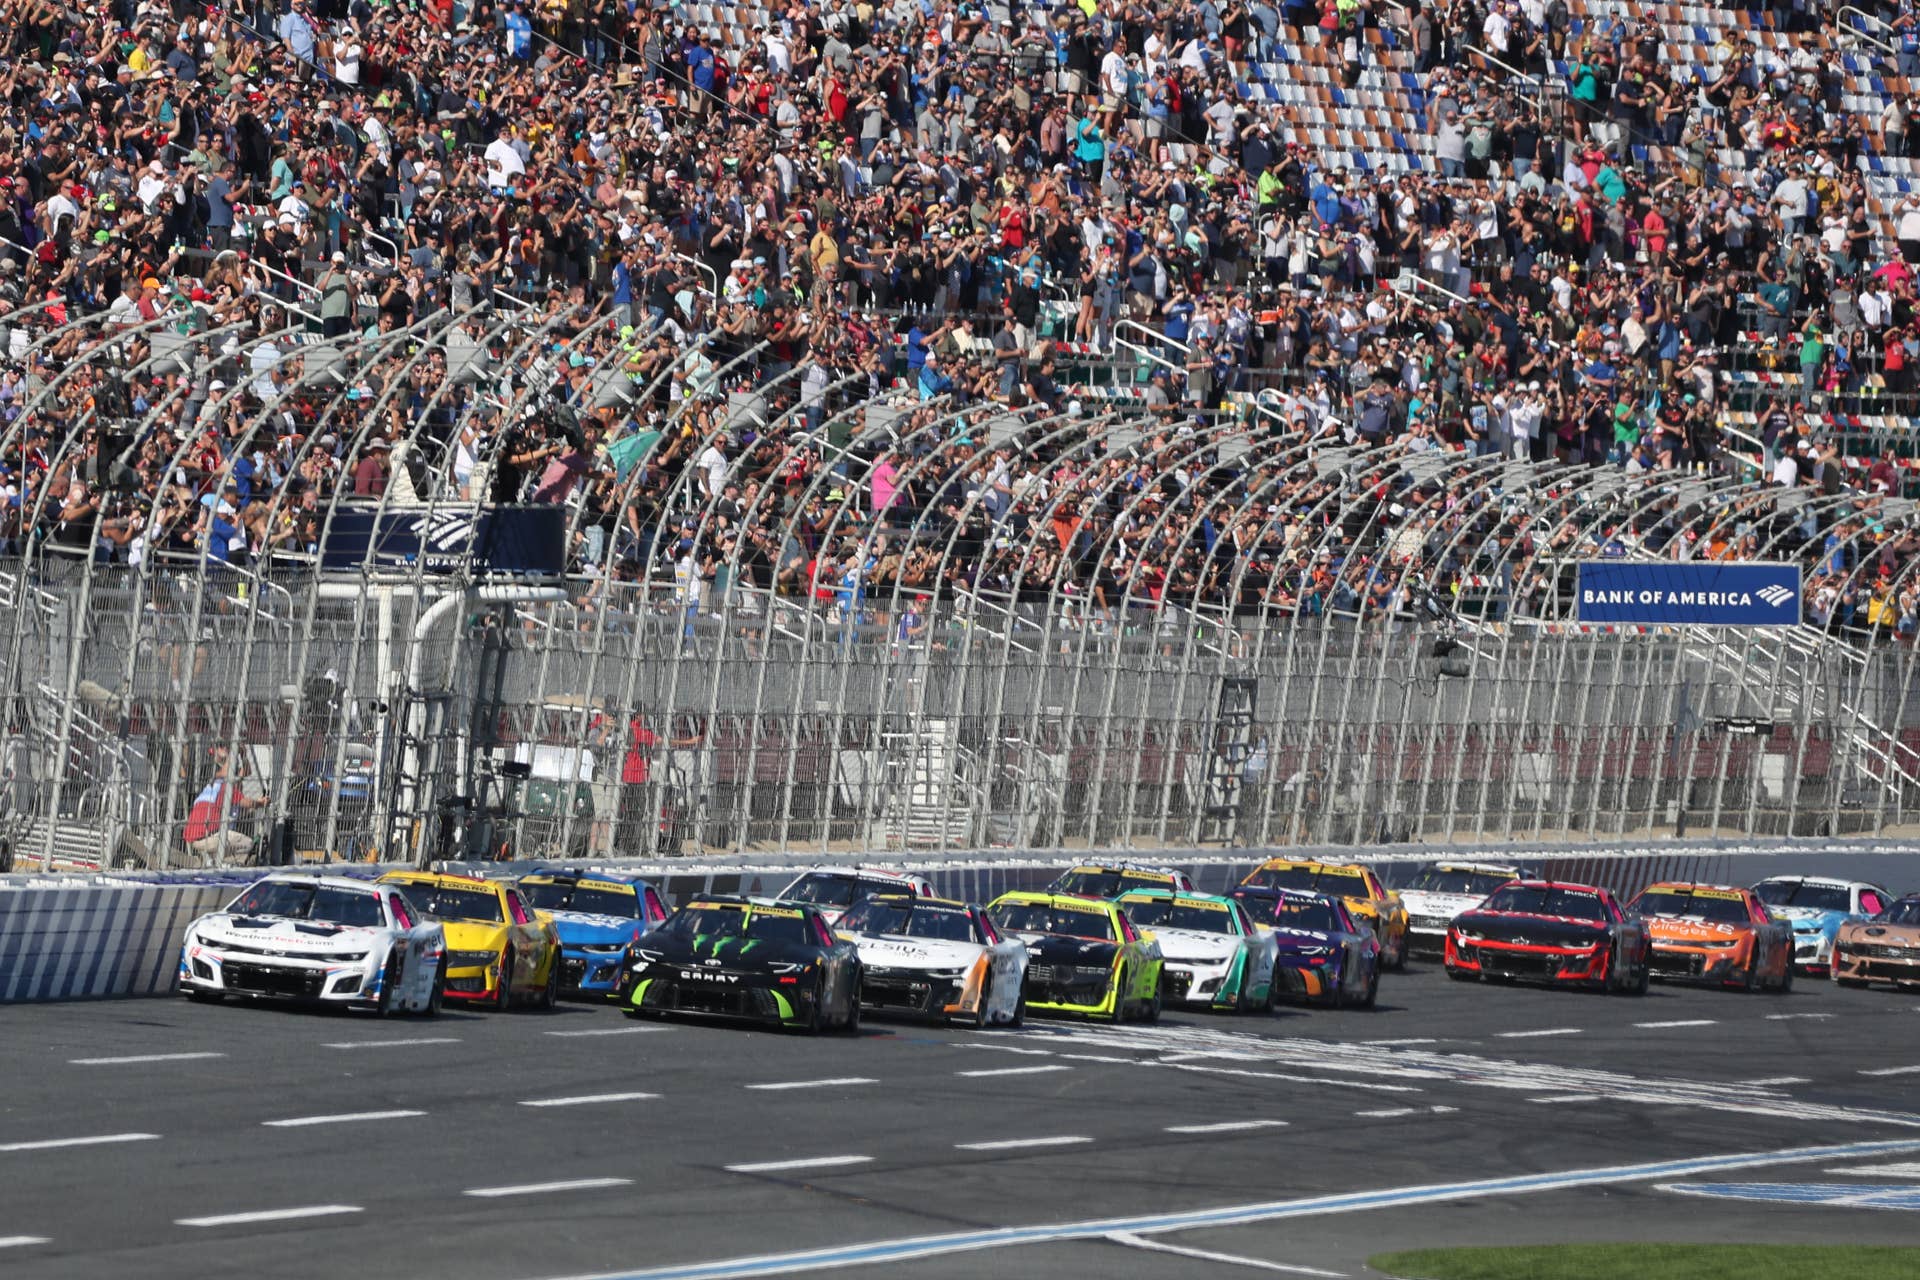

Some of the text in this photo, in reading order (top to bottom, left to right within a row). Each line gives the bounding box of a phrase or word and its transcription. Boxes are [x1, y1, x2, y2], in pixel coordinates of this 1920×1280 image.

[427, 557, 441, 567] OF
[1584, 590, 1752, 606] BANK OF AMERICA
[1564, 889, 1597, 899] BUSCH
[1179, 900, 1219, 909] ELLIOTT
[680, 971, 740, 984] CAMRY
